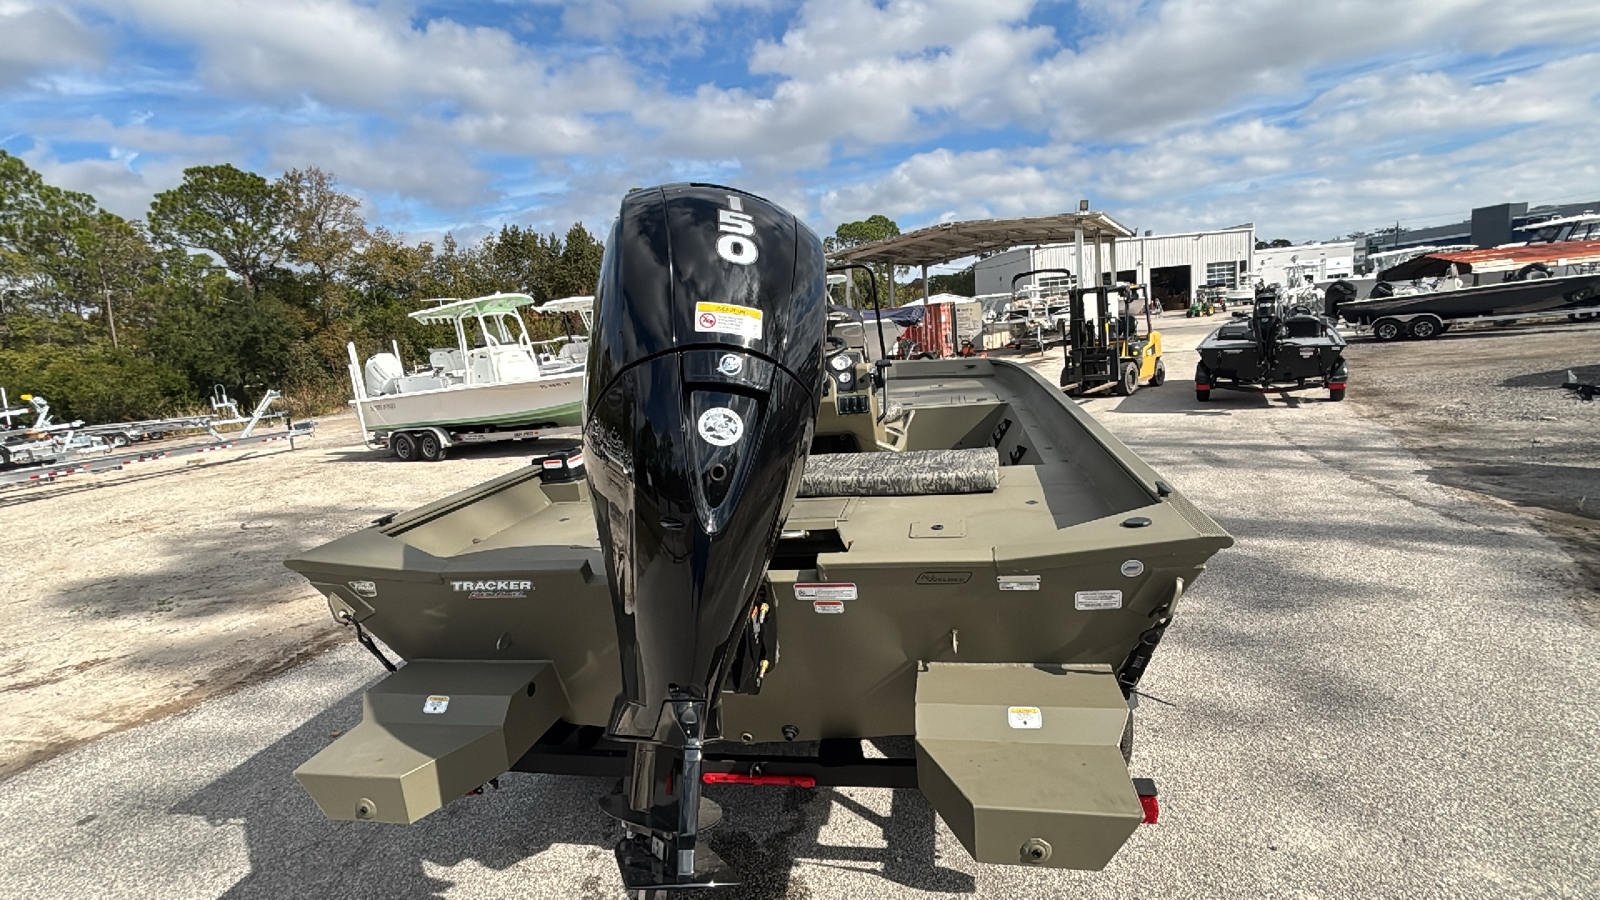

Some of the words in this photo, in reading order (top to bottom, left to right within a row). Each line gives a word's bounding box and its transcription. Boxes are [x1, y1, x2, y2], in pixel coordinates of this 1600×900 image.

[715, 194, 759, 266] 150
[721, 306, 746, 315] CAUTION
[452, 581, 532, 592] TRACKER
